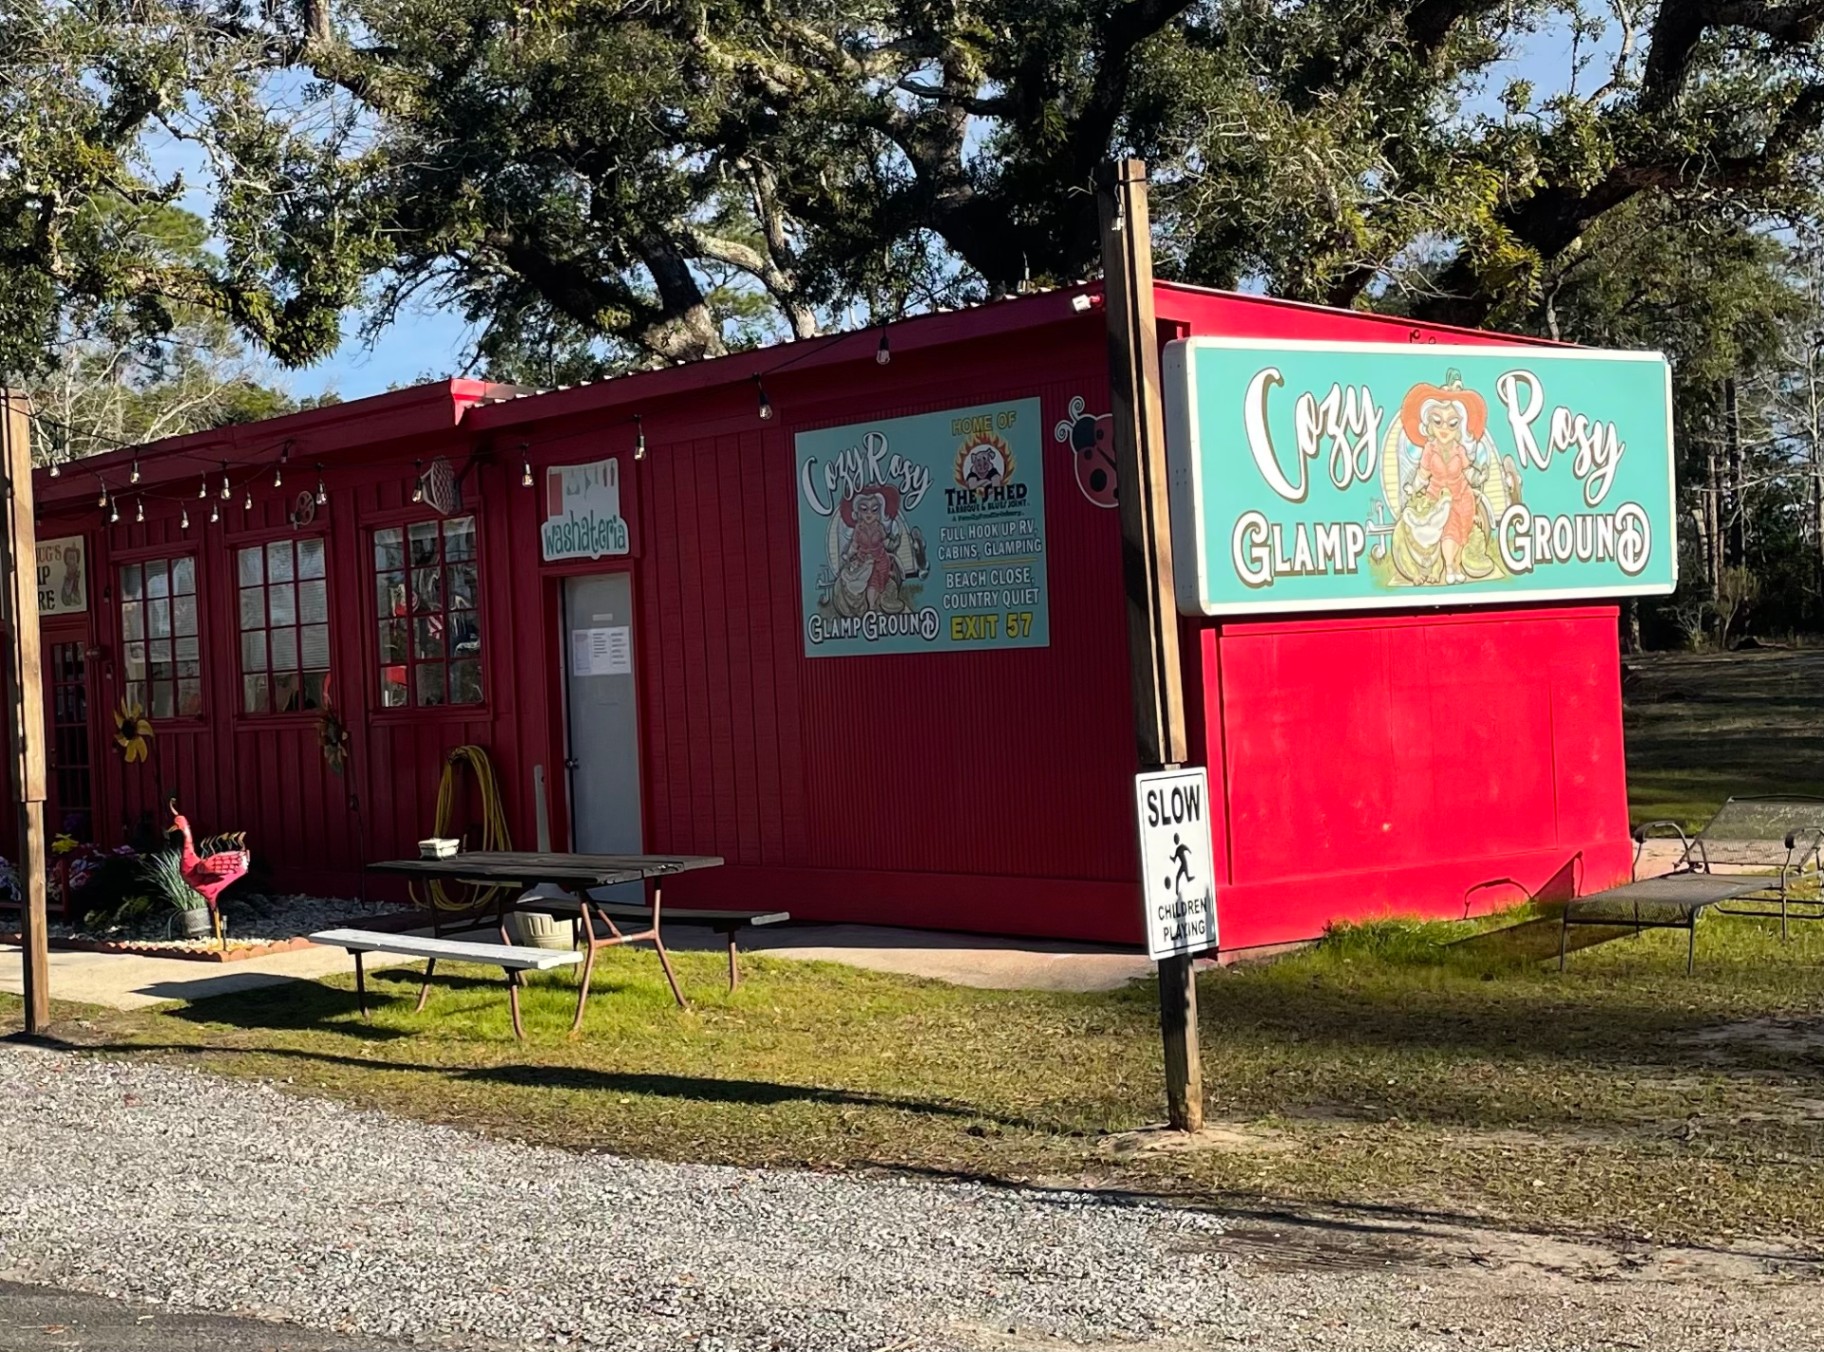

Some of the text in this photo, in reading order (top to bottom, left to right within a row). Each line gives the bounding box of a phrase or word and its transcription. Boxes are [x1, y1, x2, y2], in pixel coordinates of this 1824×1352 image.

[952, 411, 1017, 436] HOME OF
[1243, 366, 1626, 506] Cozy Rosy
[802, 431, 934, 515] Cozy Rosy
[944, 488, 977, 506] THE
[544, 510, 627, 556] washateria
[940, 527, 965, 542] FULL
[968, 524, 999, 539] HOOK
[1001, 522, 1017, 536] UP
[1231, 502, 1652, 587] GLAMP GROUND
[938, 538, 1042, 560] CABINS, GLAMPING
[946, 567, 1035, 589] BEACH CLOSE,
[943, 588, 1039, 610] COUNTRY QUIET
[951, 613, 1033, 641] EXIT 57
[1147, 784, 1201, 828] SLOW
[1157, 896, 1207, 922] CHILDREN
[1163, 919, 1206, 942] PLAYING
